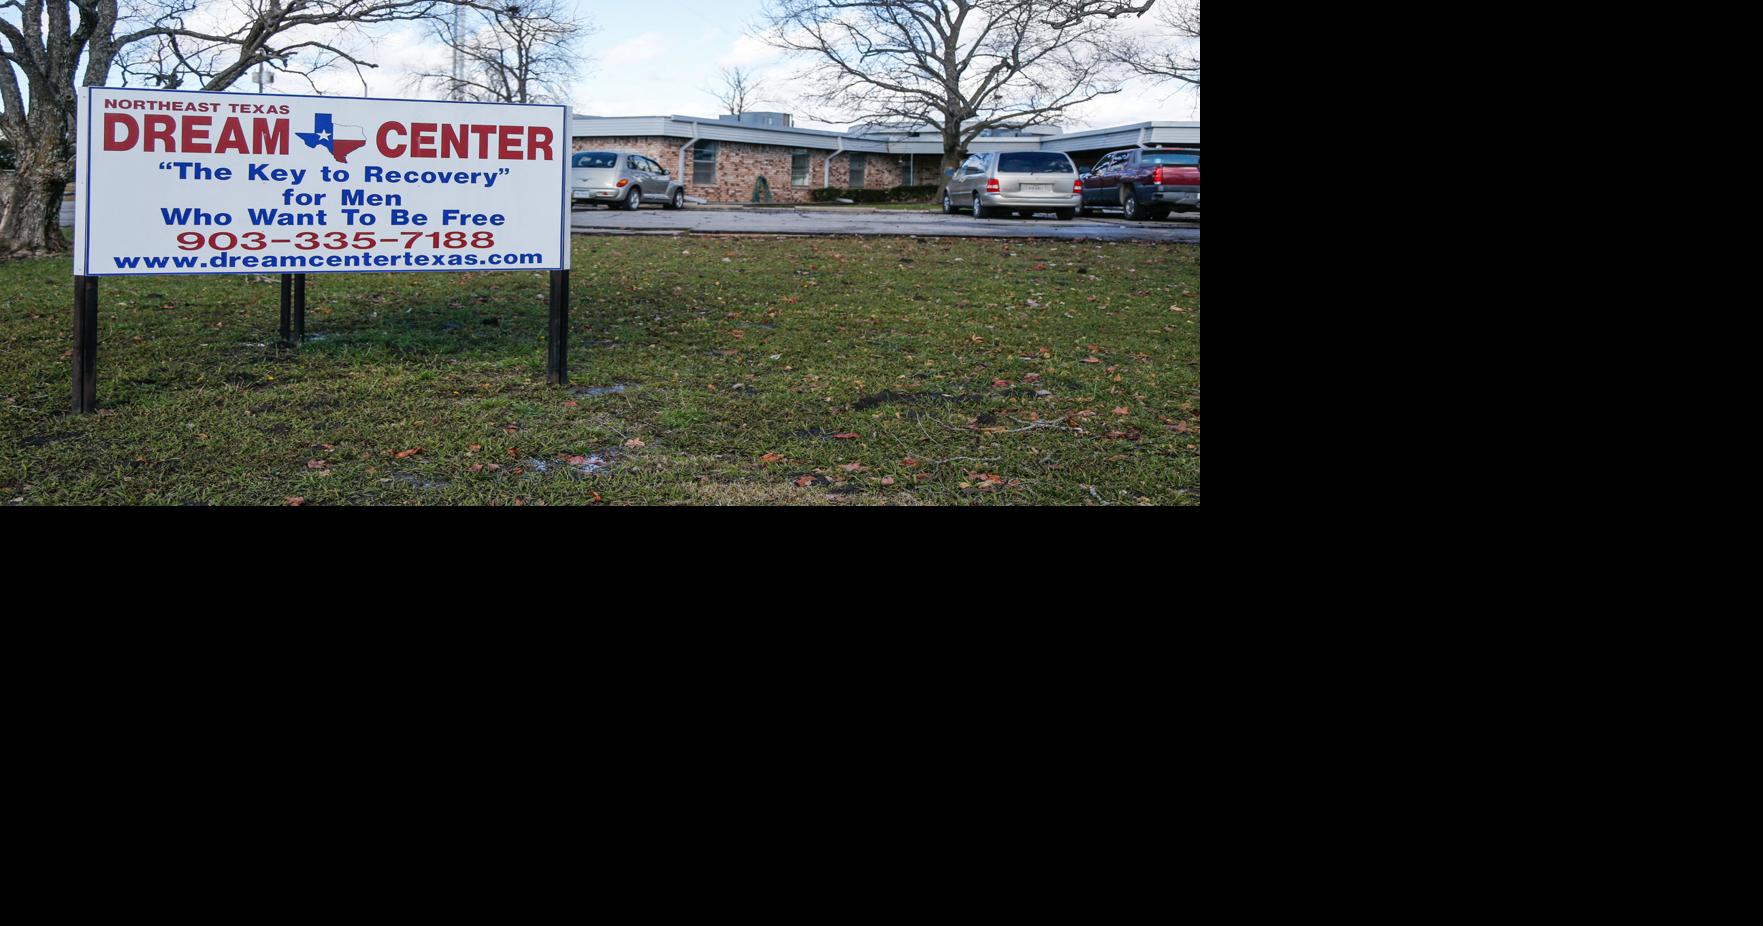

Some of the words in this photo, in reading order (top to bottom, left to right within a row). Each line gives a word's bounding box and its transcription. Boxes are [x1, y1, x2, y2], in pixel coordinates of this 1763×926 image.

[104, 98, 222, 114] NORTHEAST
[227, 103, 291, 115] TEXAS
[103, 112, 290, 155] DREAM
[376, 120, 554, 161] CENTER
[158, 161, 233, 182] “The
[247, 163, 307, 185] Key
[320, 165, 351, 183] to
[363, 166, 511, 188] Recovery”
[282, 188, 327, 206] for
[341, 189, 402, 206] Men
[160, 208, 233, 226] Who
[248, 208, 328, 227] Want
[341, 208, 377, 226] To
[390, 209, 429, 226] Be
[441, 209, 506, 226] Free
[175, 230, 495, 251] 903-335-7188
[113, 249, 543, 269] www.dreamcentertexas.com
